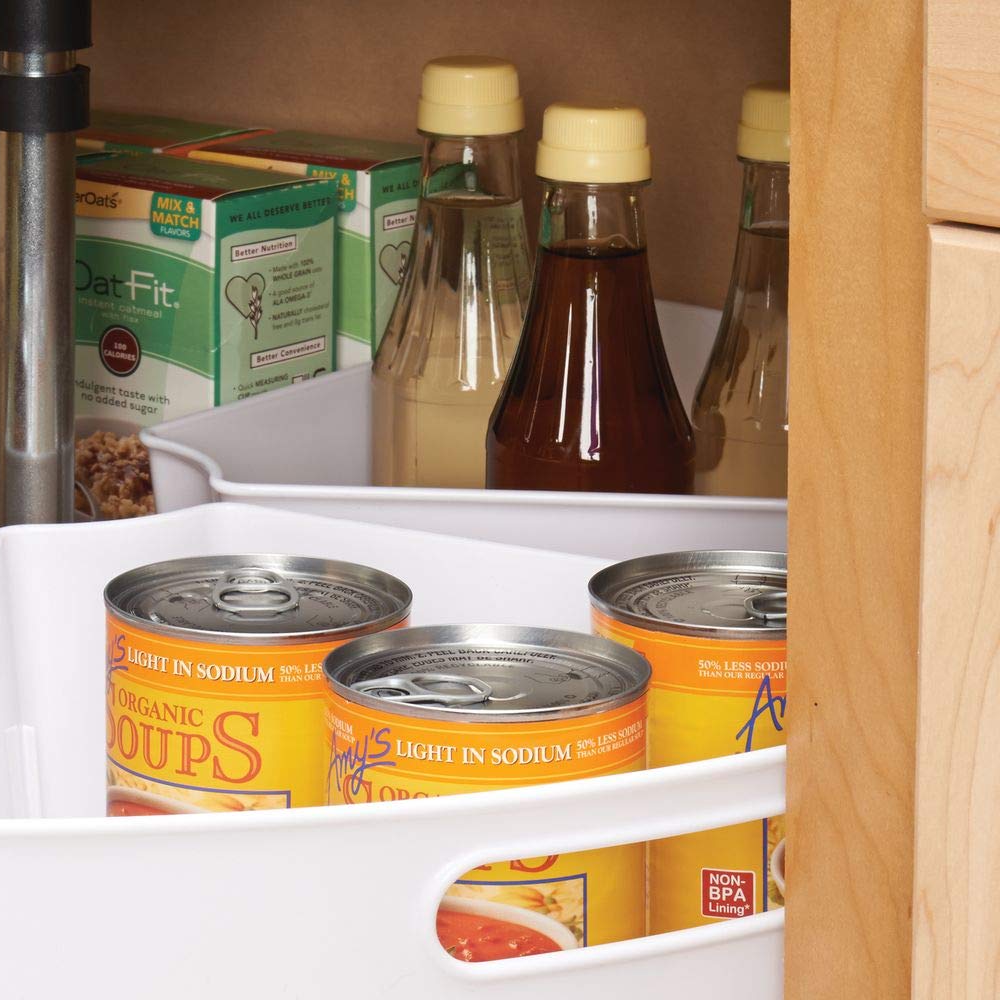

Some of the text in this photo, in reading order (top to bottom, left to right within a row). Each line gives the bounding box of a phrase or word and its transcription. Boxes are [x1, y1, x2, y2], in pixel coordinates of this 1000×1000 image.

[157, 197, 196, 214] MIX &
[230, 213, 244, 224] WE
[246, 210, 262, 221] ALL
[264, 203, 300, 218] DESERVE
[152, 211, 200, 229] MATCH
[160, 225, 191, 238] FLAVORS
[235, 240, 293, 258] Better Nutrition
[103, 348, 137, 361] CALORIES
[256, 342, 321, 363] Better Convenience
[81, 391, 158, 415] no added sugar
[118, 387, 146, 400] taste
[148, 393, 170, 405] with
[128, 646, 170, 673] LIGHT
[173, 659, 193, 677] IN
[197, 663, 276, 684] SODIUM
[280, 665, 302, 675] 50%
[698, 659, 722, 670] 50%
[725, 661, 752, 671] LESS
[280, 673, 321, 683] THAN OUR
[698, 670, 722, 678] THAN
[724, 671, 743, 679] OUR
[119, 687, 204, 727] ORGANIC
[396, 739, 457, 764] LIGHT
[462, 739, 488, 765] IN
[491, 742, 573, 766] SODIUM
[576, 739, 596, 751] 50%
[598, 731, 617, 746] LESS
[618, 720, 643, 739] SODIUM
[576, 747, 597, 758] THAN
[598, 744, 612, 754] OUR
[709, 873, 746, 886] NON-
[709, 886, 747, 902] BPA
